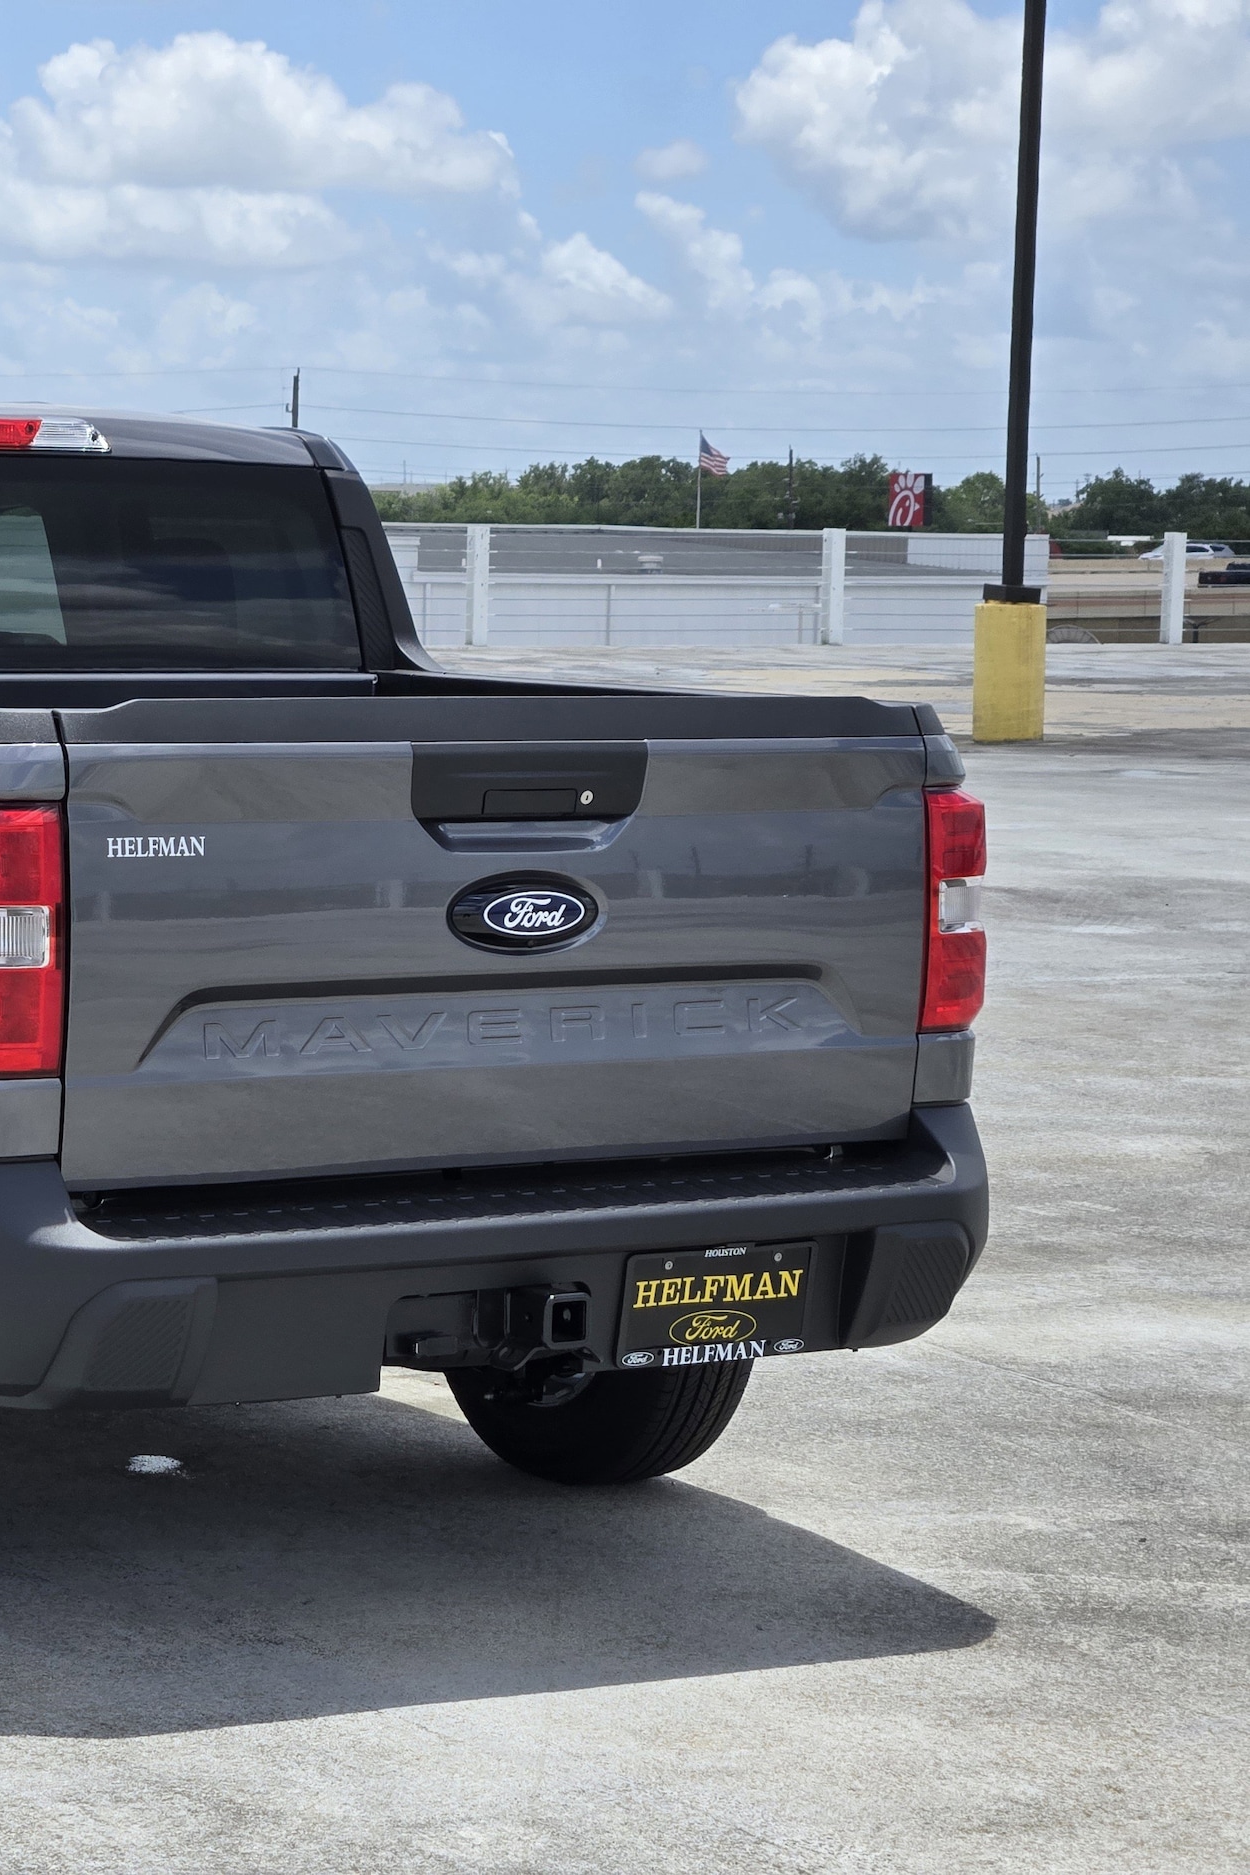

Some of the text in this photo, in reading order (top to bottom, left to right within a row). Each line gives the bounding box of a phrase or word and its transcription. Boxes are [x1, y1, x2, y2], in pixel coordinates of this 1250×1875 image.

[106, 836, 205, 857] HELFMAN
[503, 897, 567, 928] Ford
[203, 997, 801, 1060] MAVERICK
[704, 1246, 747, 1258] HOUSTON
[632, 1269, 804, 1309] HELFMAN
[684, 1314, 741, 1341] Ford
[661, 1339, 767, 1368] HELFMAN
